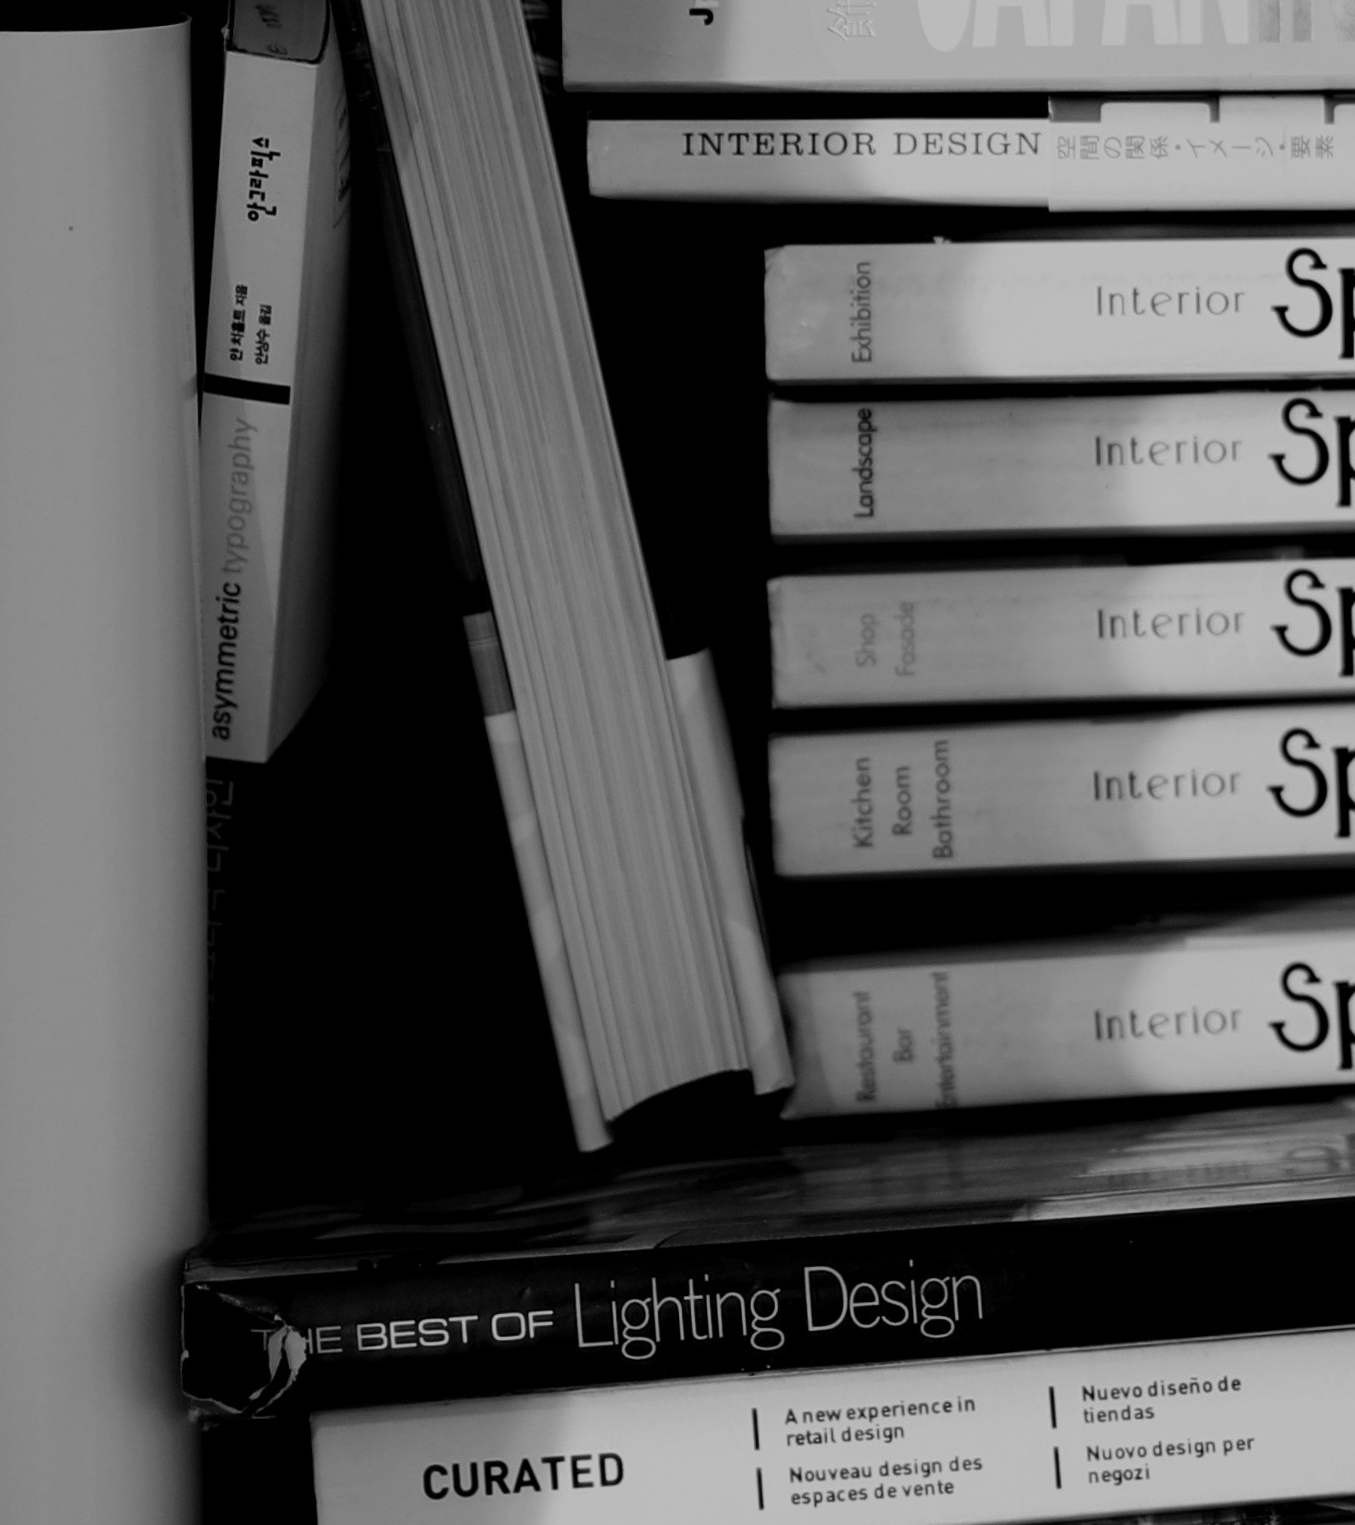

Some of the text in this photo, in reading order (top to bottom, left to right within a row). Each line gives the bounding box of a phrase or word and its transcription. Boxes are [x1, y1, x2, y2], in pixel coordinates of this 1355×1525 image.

[682, 131, 1042, 157] INTERIOR DESIGN
[850, 260, 872, 363] Exhibition
[1096, 285, 1247, 317] Interior
[851, 407, 877, 519] Landscape
[1094, 435, 1244, 467] Interior
[211, 418, 259, 741] asymmetric typography
[1097, 607, 1246, 639] Interior
[856, 612, 880, 668] Shop
[892, 765, 912, 836] Room
[930, 738, 953, 859] Bathroom
[1093, 769, 1241, 801] Interior
[851, 756, 873, 848] Kitchen
[1095, 1005, 1242, 1041] Interior
[853, 991, 876, 1102] Restaurant
[892, 1028, 914, 1063] Bar
[357, 1259, 984, 1360] BEST OF Lighting Design
[1081, 1376, 1212, 1402] Nuevo diseño
[802, 1399, 953, 1424] new experience
[1083, 1404, 1155, 1423] tiendas
[786, 1424, 905, 1447] retail design
[1086, 1436, 1255, 1462] Nuovo design per
[422, 1452, 625, 1500] CURATED
[789, 1455, 983, 1483] Nouveau design des
[1088, 1464, 1150, 1485] negozi
[791, 1480, 955, 1508] espaces vente
